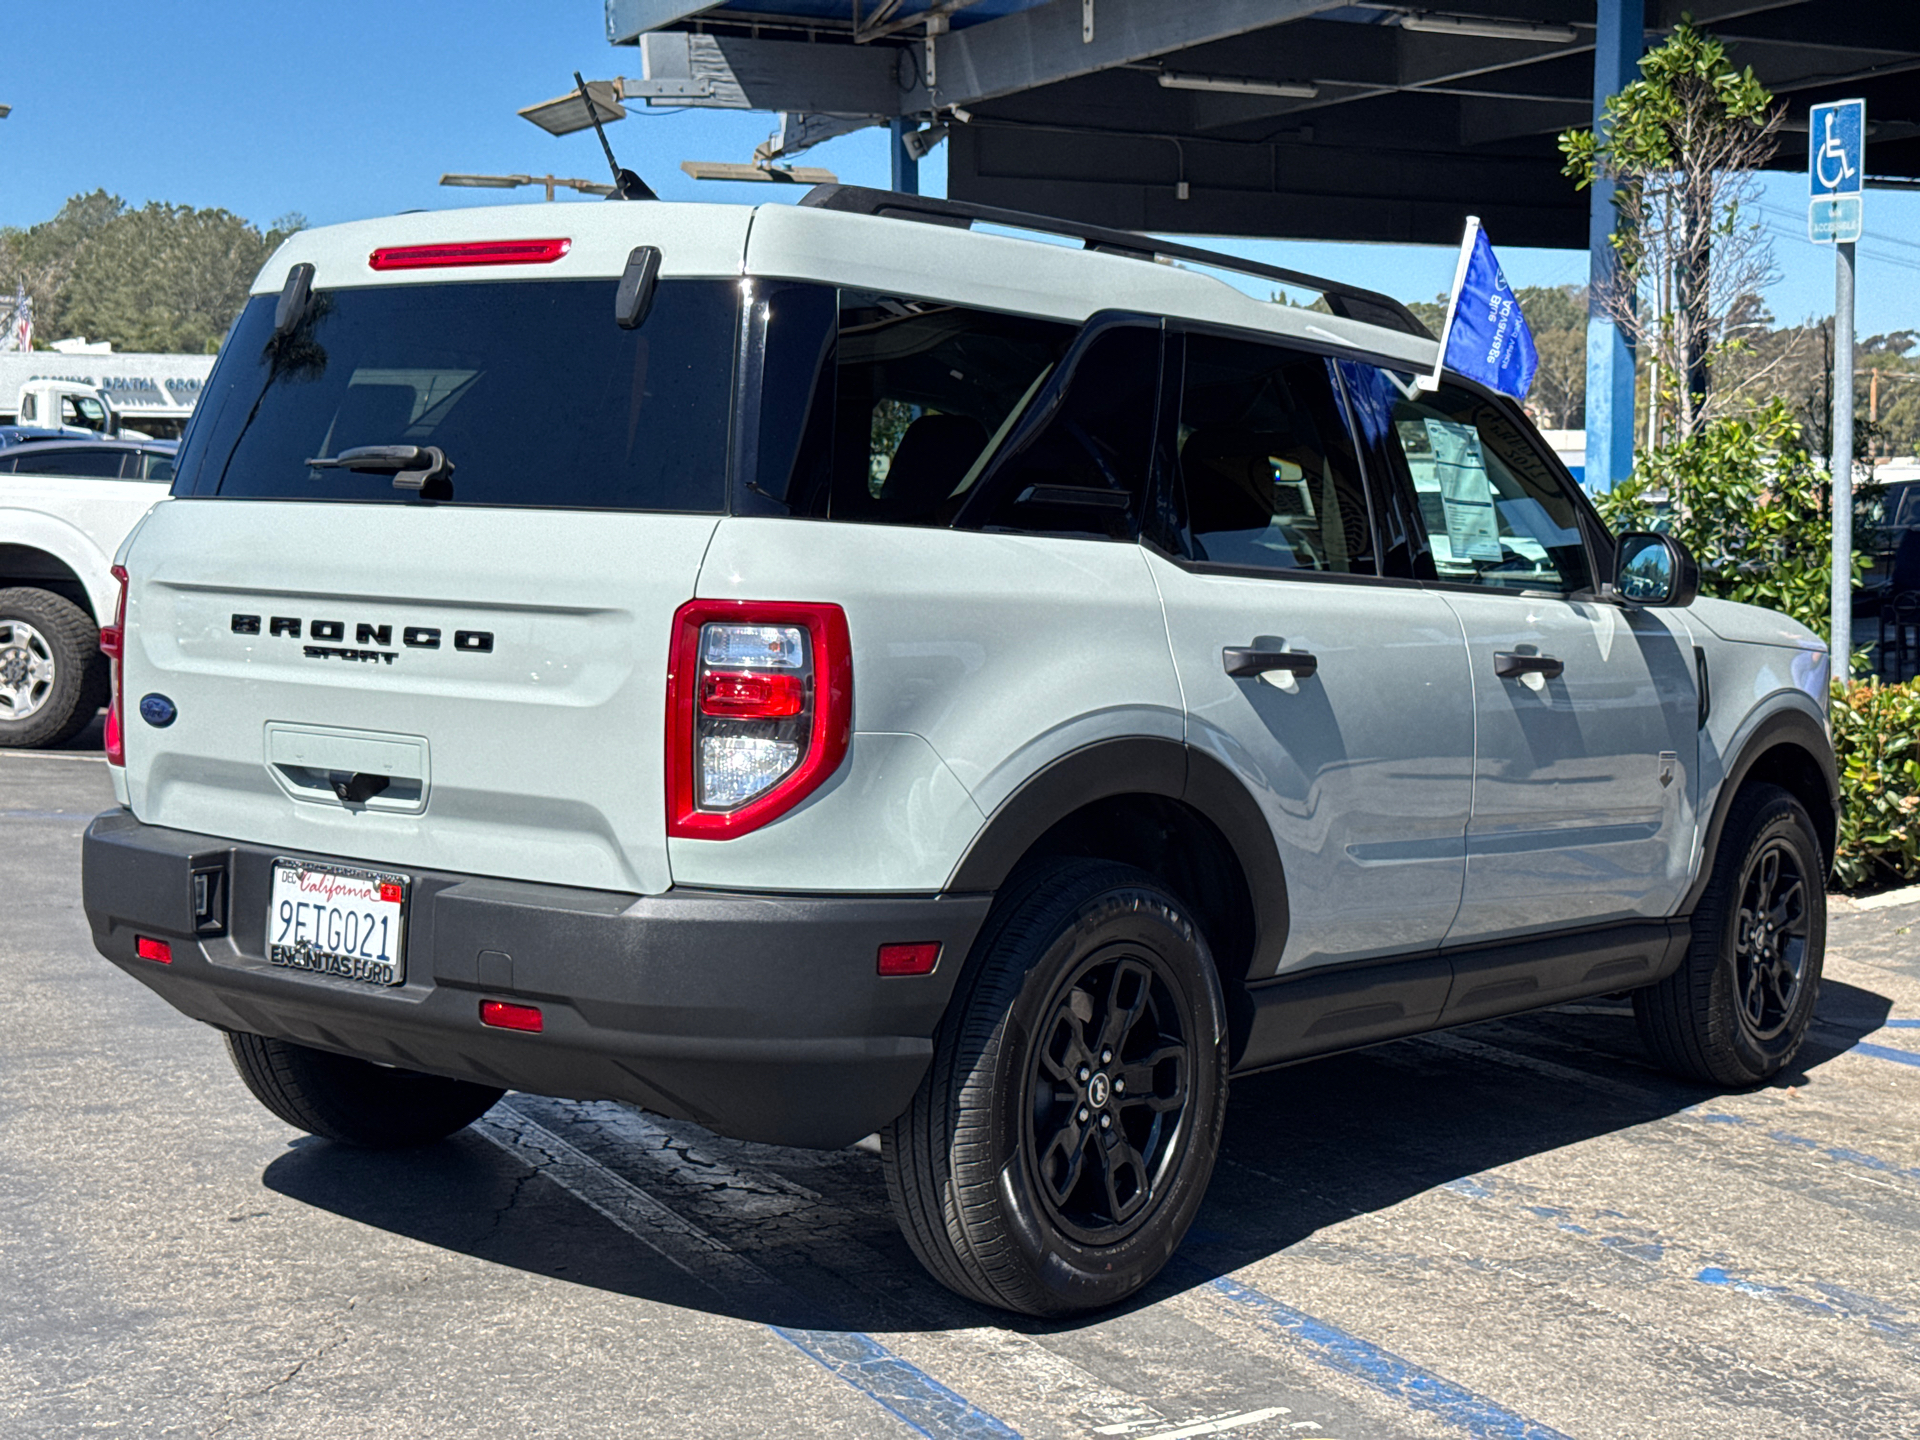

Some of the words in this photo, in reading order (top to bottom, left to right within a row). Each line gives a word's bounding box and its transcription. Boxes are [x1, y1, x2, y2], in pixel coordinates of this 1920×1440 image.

[102, 376, 158, 392] DENTAL
[231, 613, 494, 653] BRONCO
[303, 645, 399, 665] SPORT
[281, 870, 297, 885] DEC
[300, 871, 380, 903] California
[277, 899, 390, 962] 9EIG021
[271, 945, 352, 976] ENCINITAS
[353, 961, 394, 984] FORD
